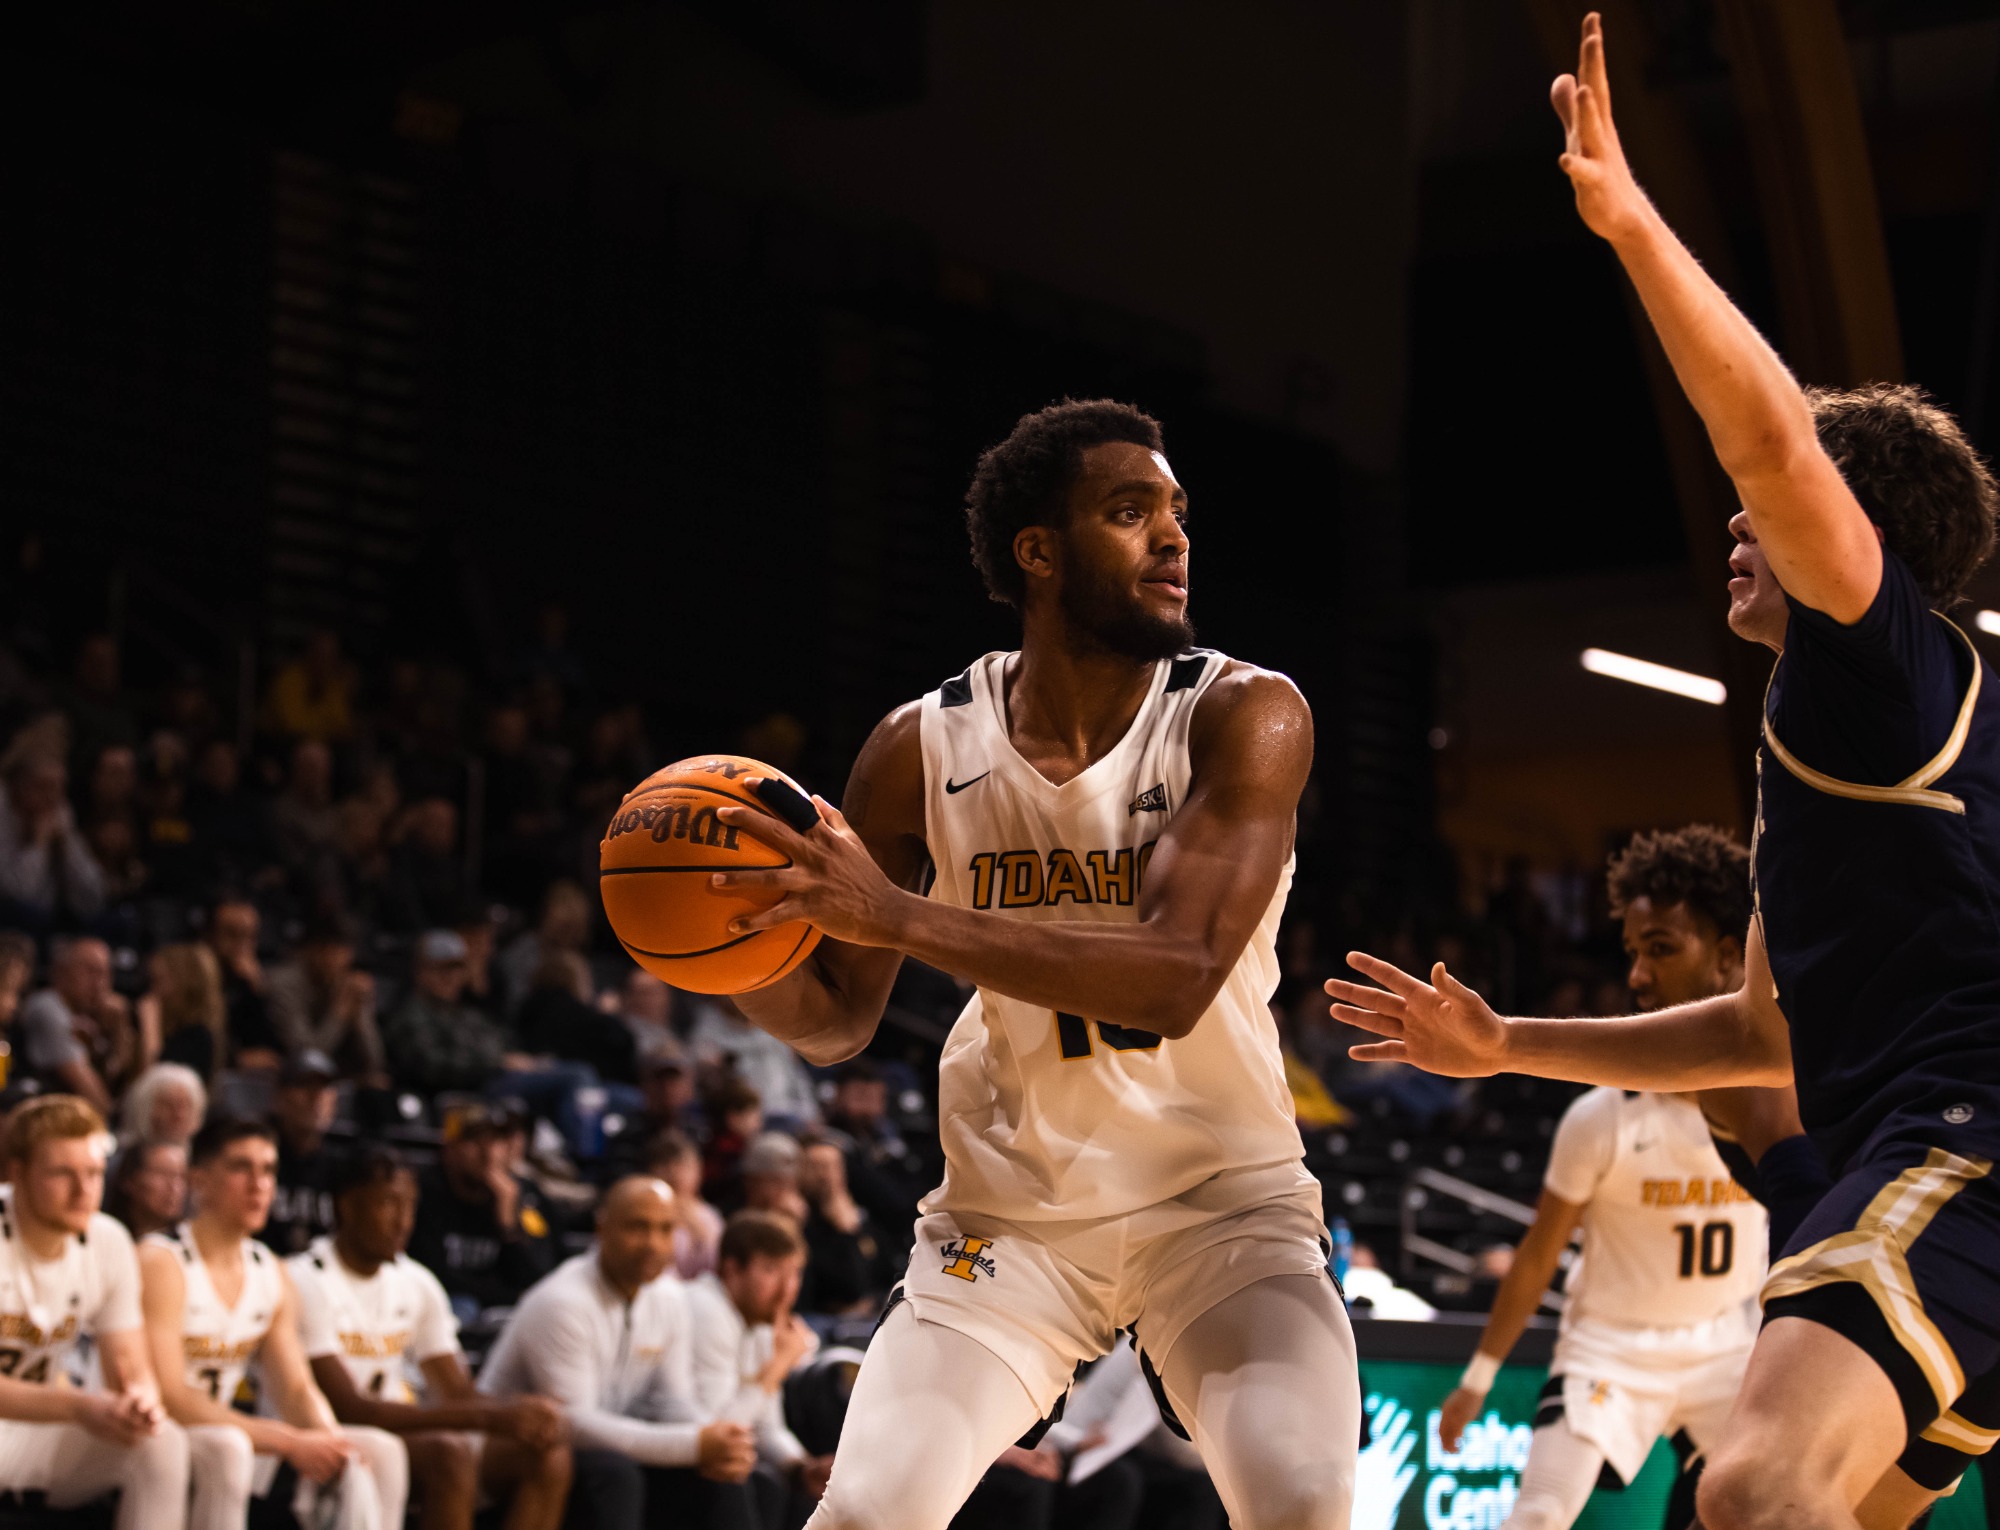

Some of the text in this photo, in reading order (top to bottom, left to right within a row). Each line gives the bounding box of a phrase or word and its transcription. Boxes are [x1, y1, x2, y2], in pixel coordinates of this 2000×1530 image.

[609, 804, 740, 851] Wilson
[940, 1241, 996, 1278] Vandals
[1673, 1221, 1734, 1279] 10
[1426, 1409, 1533, 1472] Iaho
